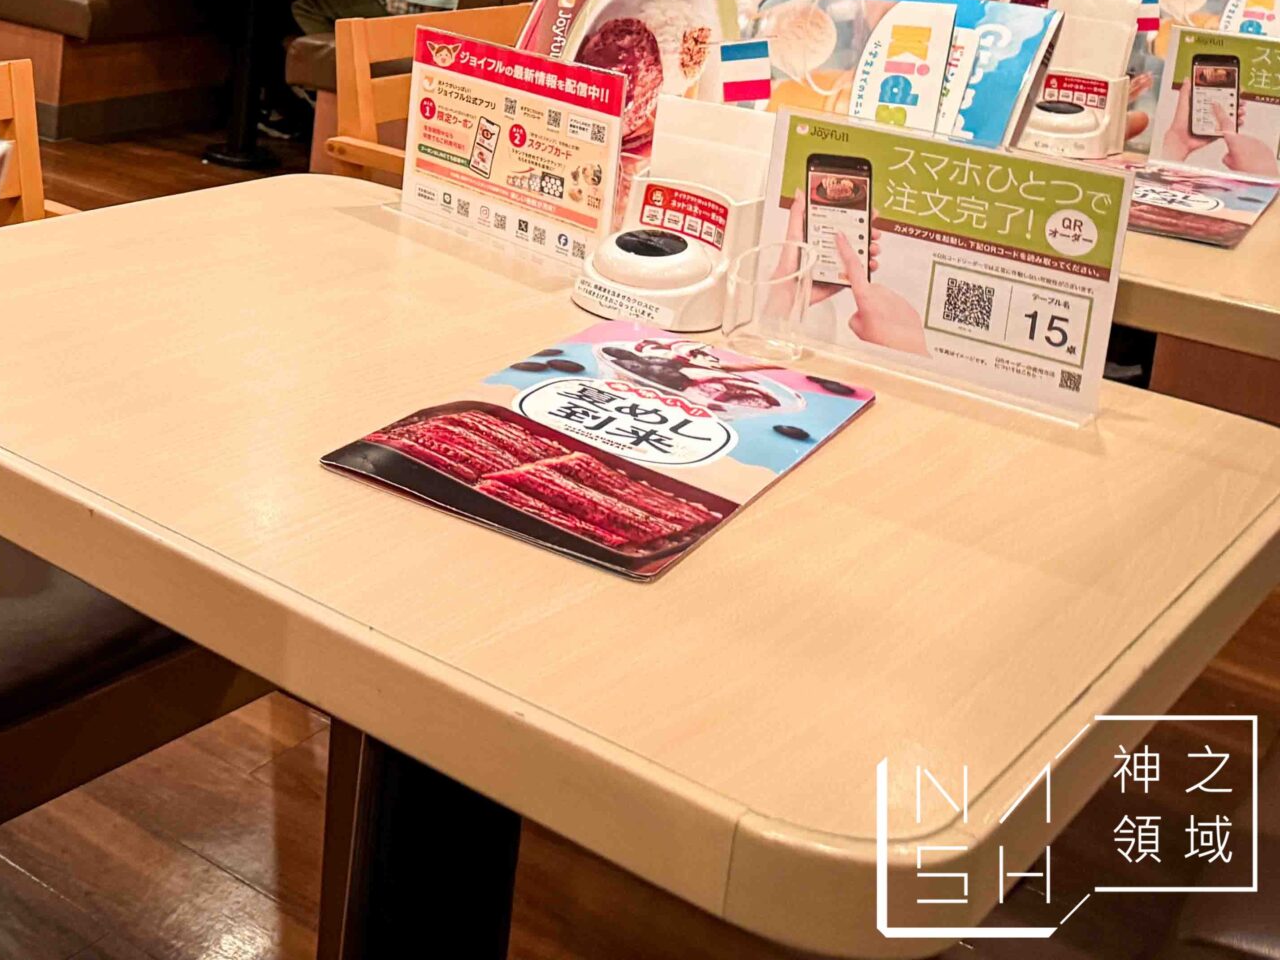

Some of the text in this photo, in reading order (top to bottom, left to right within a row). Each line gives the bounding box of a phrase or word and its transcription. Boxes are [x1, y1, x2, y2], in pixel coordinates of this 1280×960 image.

[460, 51, 609, 103] ジョイフルの最新情報を配信中!!
[437, 87, 496, 110] ジョイフル公式アプリ
[424, 106, 431, 117] 1
[437, 111, 474, 129] 限定クーポン
[514, 133, 521, 145] 2
[810, 126, 849, 143] Joyfull
[527, 138, 573, 159] スタンプカード
[888, 147, 1112, 215] スマホひとつで
[884, 179, 1034, 240] 注文完了!
[1062, 217, 1083, 234] QR
[1048, 228, 1093, 245] オーダー
[1032, 293, 1070, 310] テーブル名
[557, 383, 712, 442] 夏めし
[548, 401, 674, 454] 到来
